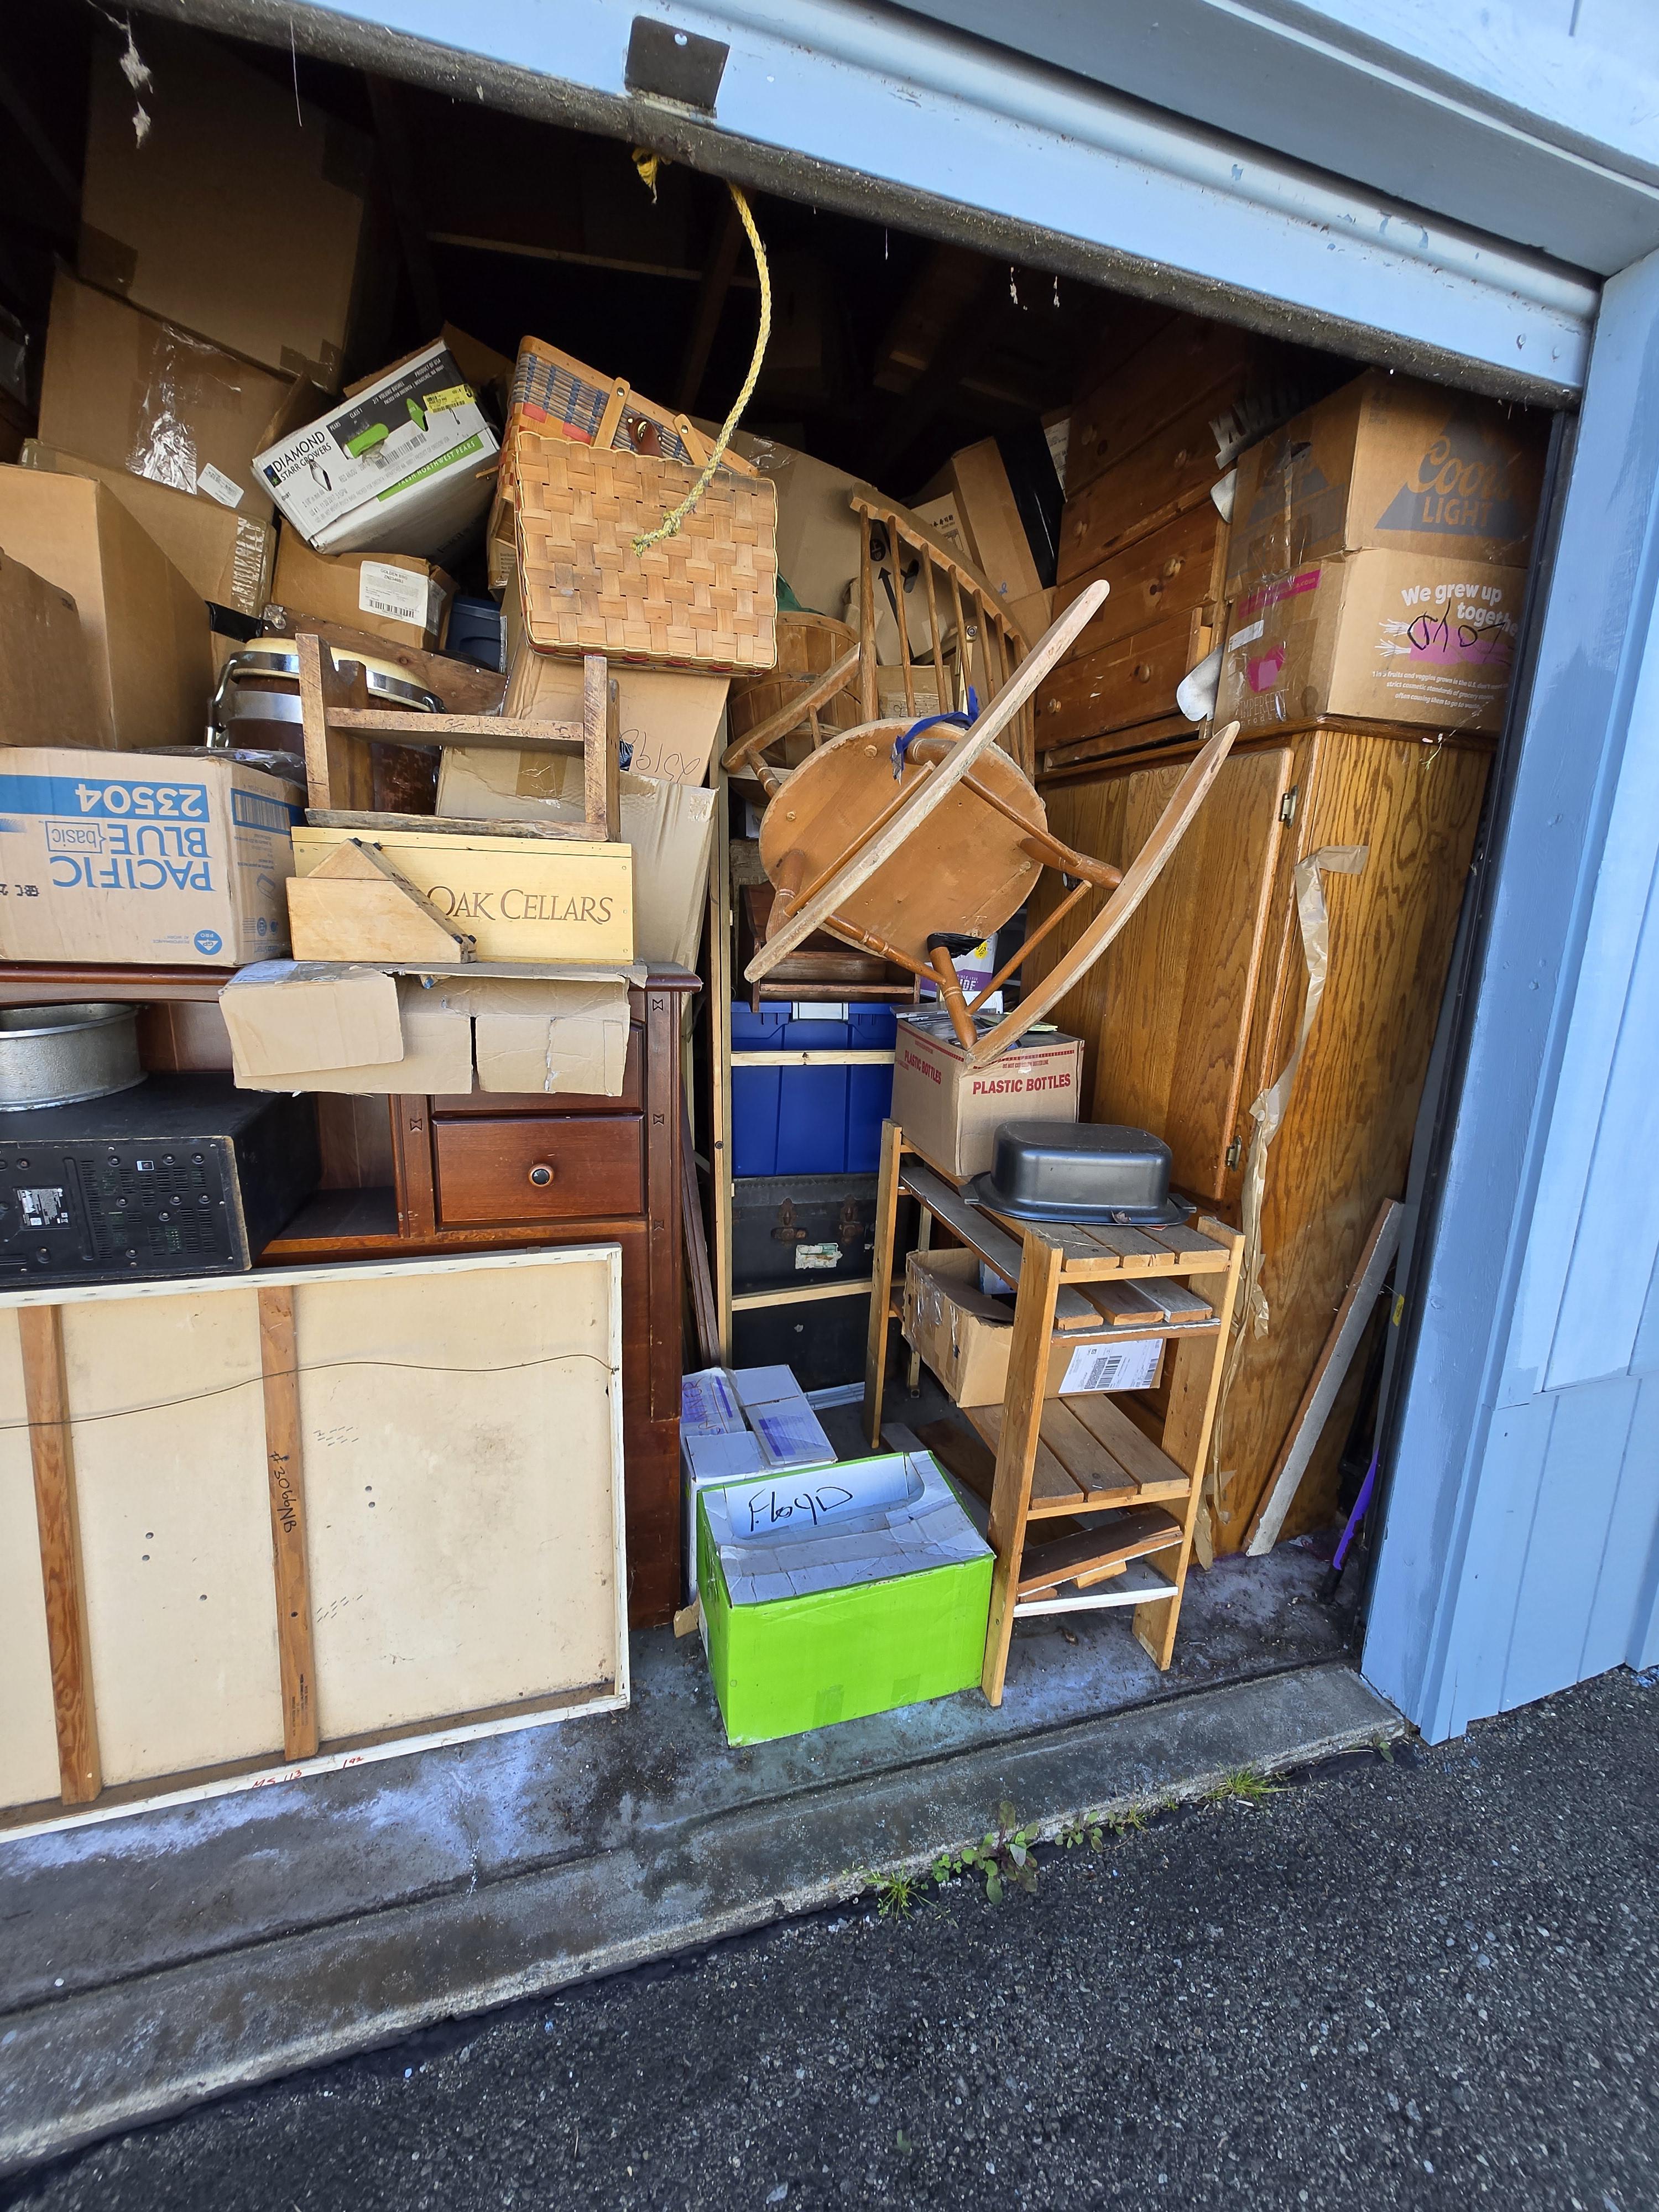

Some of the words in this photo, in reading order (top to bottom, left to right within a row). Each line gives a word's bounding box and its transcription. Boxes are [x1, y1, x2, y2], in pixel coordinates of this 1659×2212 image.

[330, 421, 341, 431] PEARS
[349, 409, 360, 419] CLASS
[272, 431, 325, 473] DIAMOND
[280, 463, 301, 481] STARR
[300, 442, 332, 466] GROWERS
[417, 451, 455, 476] NORTHWEST
[456, 441, 476, 455] PEARS
[1422, 496, 1494, 526] LIGHT
[1401, 586, 1431, 606] We
[1436, 584, 1479, 604] grew
[1481, 586, 1502, 606] up
[1457, 602, 1519, 637] togethe
[1402, 682, 1426, 691] cosmetic
[1427, 686, 1452, 695] standards
[1459, 691, 1479, 700] grocery
[1416, 674, 1436, 682] veggies
[1411, 695, 1431, 704] causing
[1431, 696, 1444, 704] them
[75, 784, 203, 817] 23504
[51, 828, 97, 848] basic
[107, 823, 213, 858] BLUE
[49, 855, 217, 891] PACIFIC
[427, 885, 495, 920] OAK
[500, 889, 613, 925] CELLARS
[904, 1050, 921, 1071] PLASTIC
[921, 1060, 942, 1085] BOTTLES
[973, 1079, 1022, 1094] PLASTIC
[1026, 1073, 1071, 1091] BOTTLES
[252, 1777, 275, 1788] MS
[284, 1770, 302, 1782] 113
